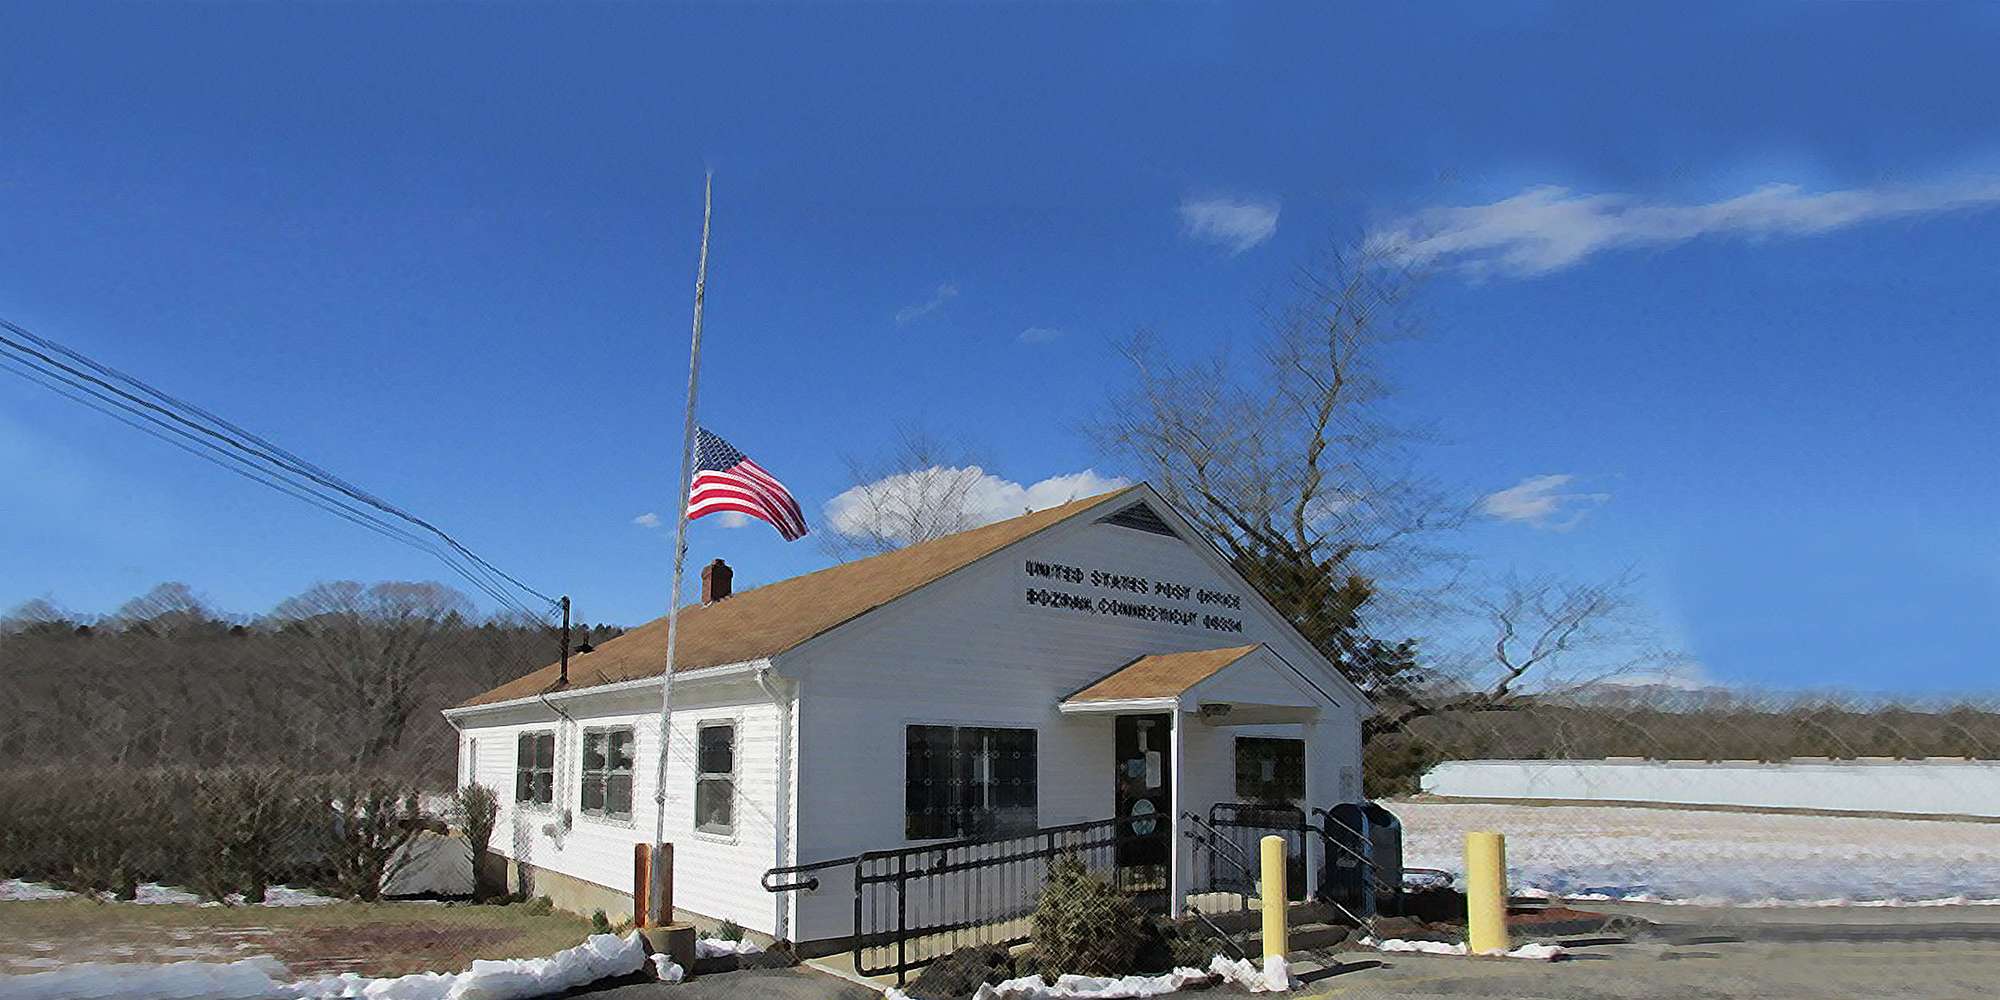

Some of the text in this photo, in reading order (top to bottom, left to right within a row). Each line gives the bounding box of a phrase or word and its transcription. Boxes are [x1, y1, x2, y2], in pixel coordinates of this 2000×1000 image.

[1026, 560, 1240, 611] UNITED STATES POST OFFICE
[1099, 598, 1198, 625] CONNECTICUT
